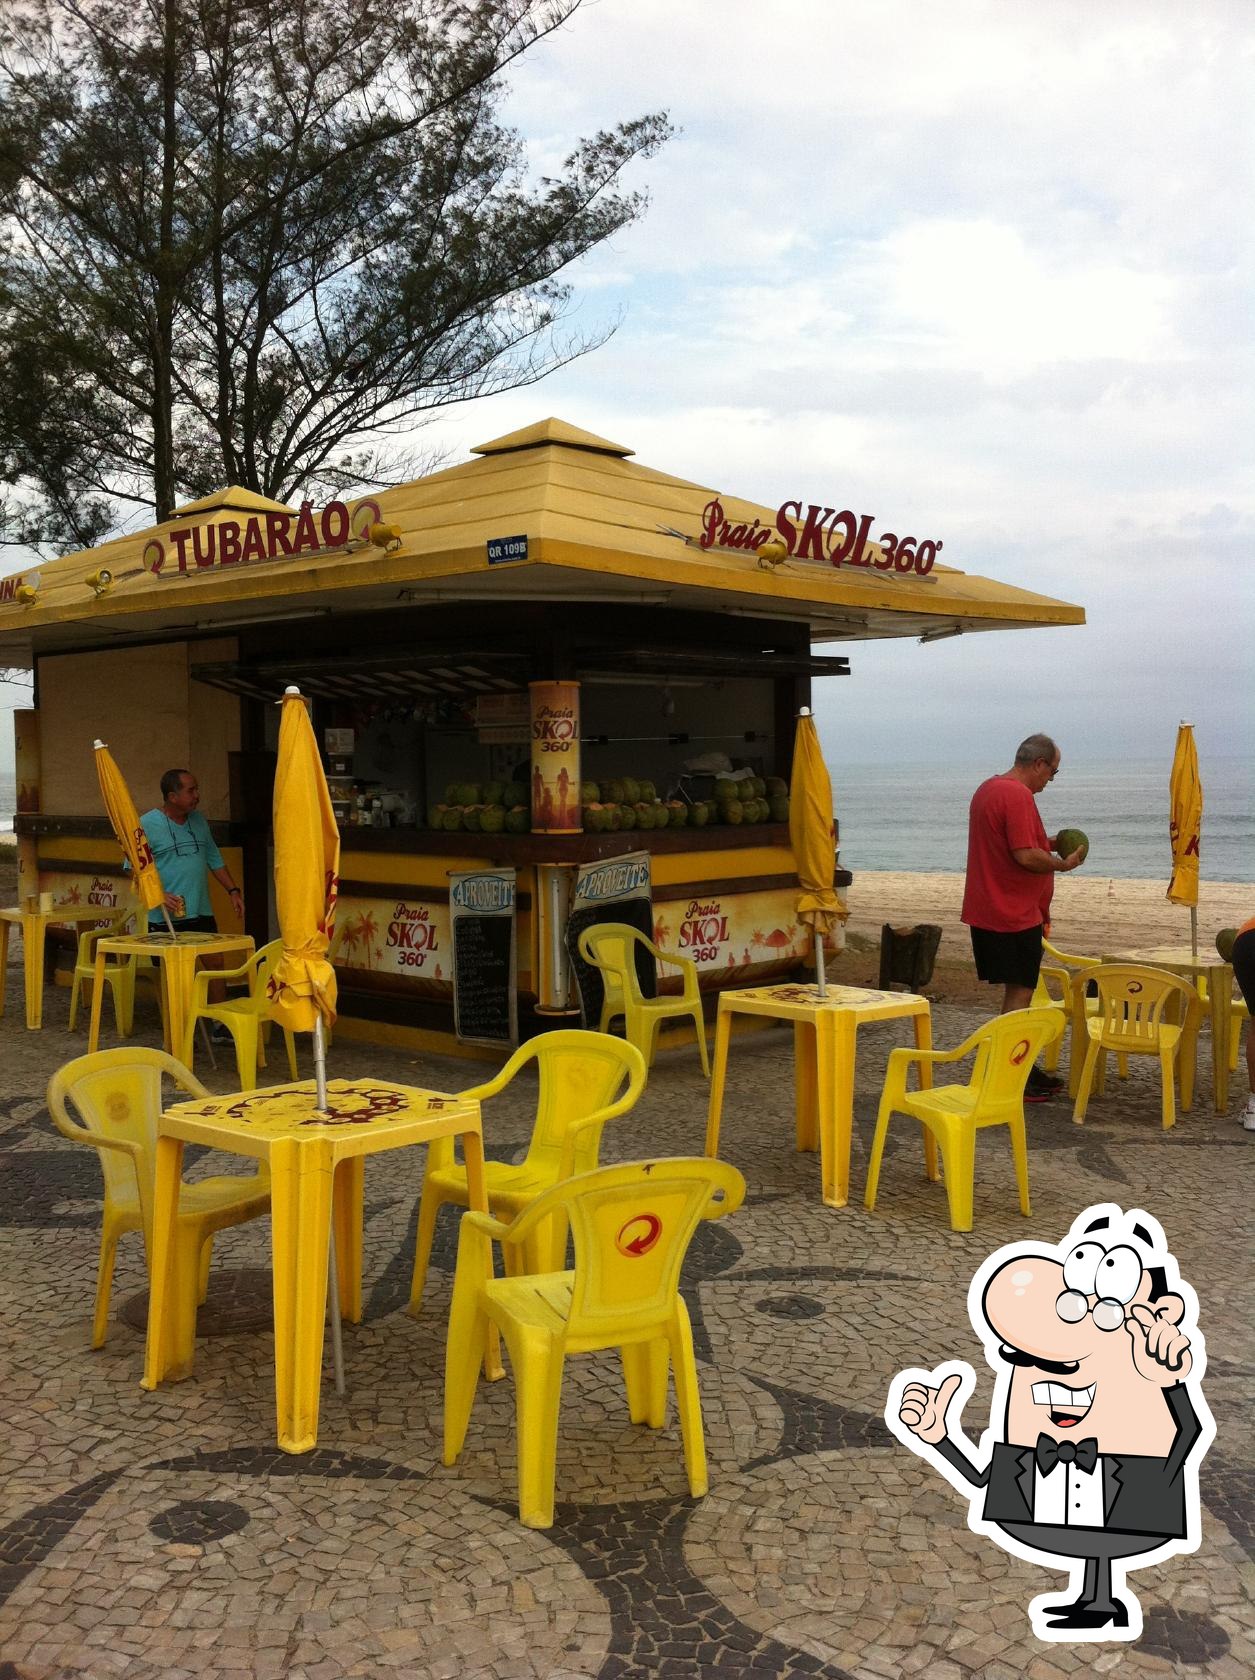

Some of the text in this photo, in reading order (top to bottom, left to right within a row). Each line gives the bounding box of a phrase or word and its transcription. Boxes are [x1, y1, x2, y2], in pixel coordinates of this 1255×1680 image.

[170, 500, 349, 572] TUBARÃO
[700, 497, 772, 549] Praia
[776, 500, 876, 568] SKOL
[489, 546, 502, 558] QR
[536, 705, 574, 718] Praia
[533, 719, 579, 740] SKOL
[576, 862, 650, 899] APROVEITE
[393, 902, 429, 922] Praia
[685, 900, 721, 919] Praia
[385, 921, 439, 952] SKOL
[678, 916, 730, 948] SKOL
